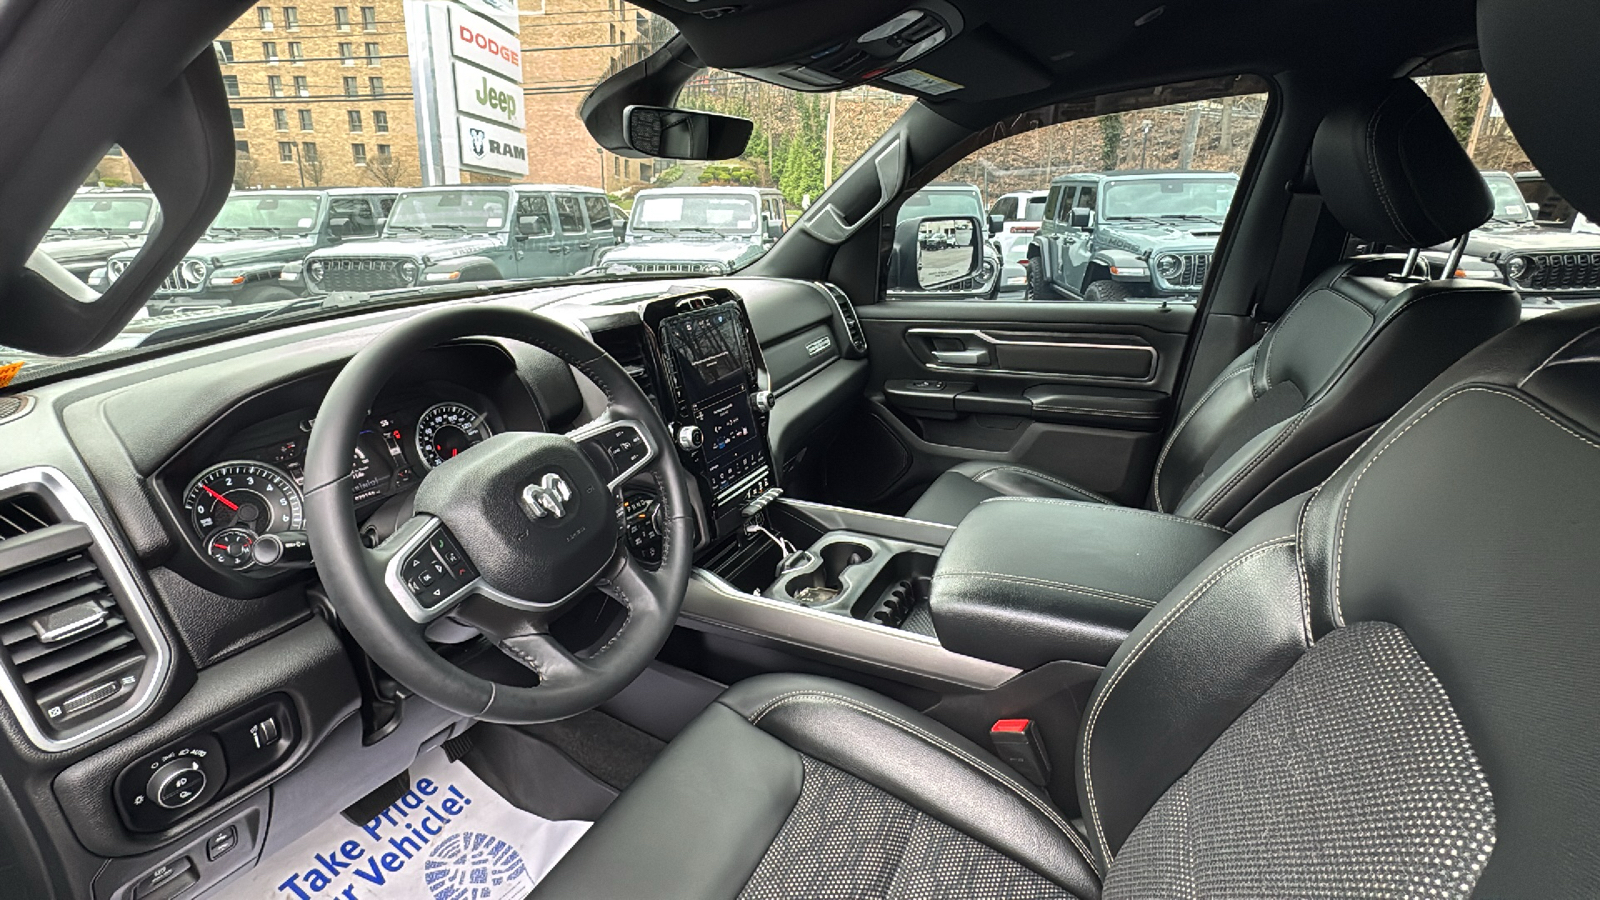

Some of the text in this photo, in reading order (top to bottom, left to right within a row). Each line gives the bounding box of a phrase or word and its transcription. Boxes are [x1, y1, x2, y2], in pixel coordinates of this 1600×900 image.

[459, 25, 519, 67] DODGE
[475, 77, 517, 120] Jeep
[489, 139, 526, 161] RAM
[225, 478, 232, 486] 2
[246, 477, 254, 485] 3
[280, 498, 287, 506] 5
[278, 778, 439, 900] Take Pride
[353, 784, 472, 886] Vehicle!
